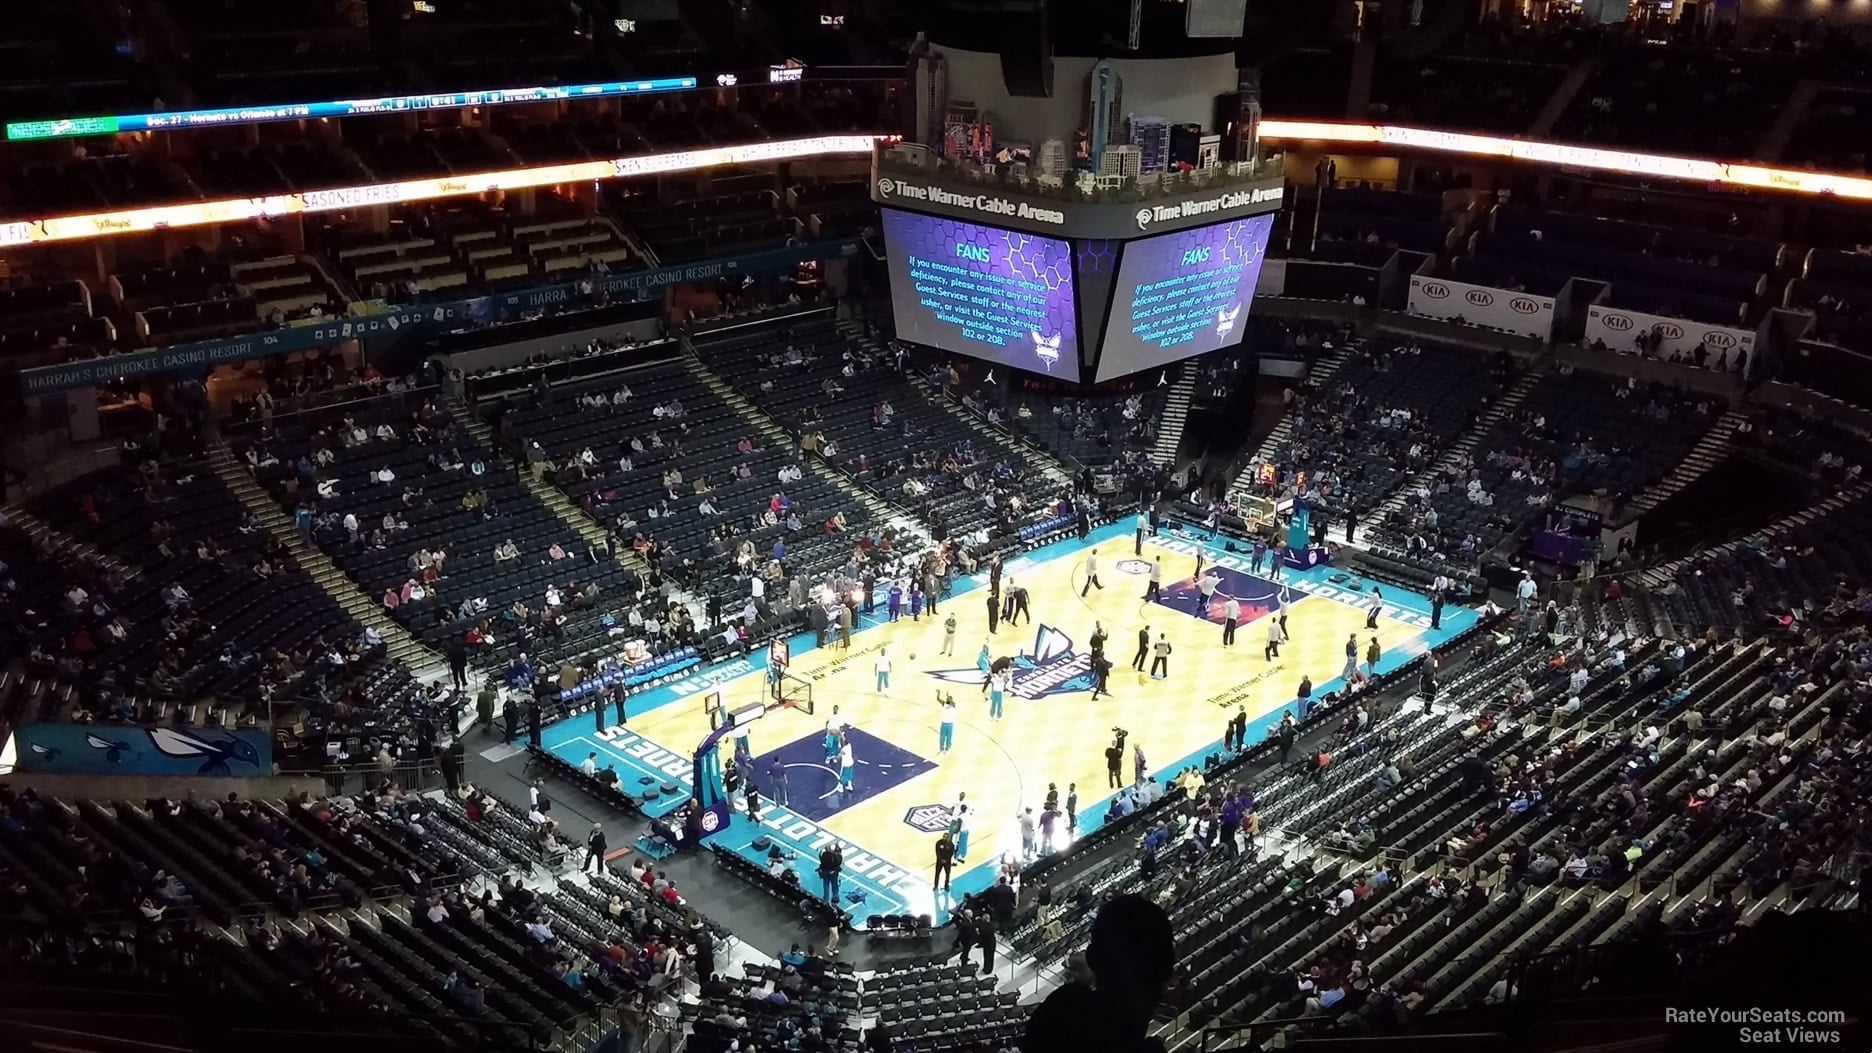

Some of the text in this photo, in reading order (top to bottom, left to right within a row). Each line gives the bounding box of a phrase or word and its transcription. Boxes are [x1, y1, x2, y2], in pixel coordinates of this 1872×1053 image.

[190, 114, 226, 123] Hornets
[240, 110, 275, 119] Orlando
[366, 185, 400, 201] FRIES
[895, 180, 1064, 224] Time Warner Cable Arena
[1152, 187, 1284, 222] Time Warner Cable Arena
[957, 243, 990, 263] FANS
[1181, 246, 1211, 266] FANS
[529, 288, 567, 305] HARRA
[600, 277, 641, 293] EROKEE
[646, 270, 682, 288] CASINO
[686, 263, 722, 280] RESORT
[910, 256, 915, 266] If
[917, 259, 930, 269] you
[932, 262, 968, 276] encounter
[970, 270, 984, 280] any
[985, 272, 1005, 284] issue
[1017, 280, 1045, 292] service
[911, 269, 1046, 305] deficiency, please contact any of our
[1426, 285, 1446, 296] KIA
[916, 282, 1046, 318] Guest Services staff or the nearest
[1469, 292, 1490, 304] KIA
[1513, 299, 1535, 311] KIA
[921, 297, 1043, 331] usher, or visit the Guest Services
[1606, 316, 1629, 329] KIA
[937, 312, 1023, 339] window outside section
[962, 328, 975, 338] 102
[1657, 325, 1678, 337] KIA
[1708, 334, 1730, 346] KIA
[96, 358, 158, 378] CHEROKEE
[164, 350, 205, 367] CASINO
[210, 342, 253, 359] RESORT
[812, 666, 847, 681] Arna
[1010, 653, 1091, 698] HORNETS
[1219, 693, 1250, 708] Arena
[594, 725, 697, 787] RNETS
